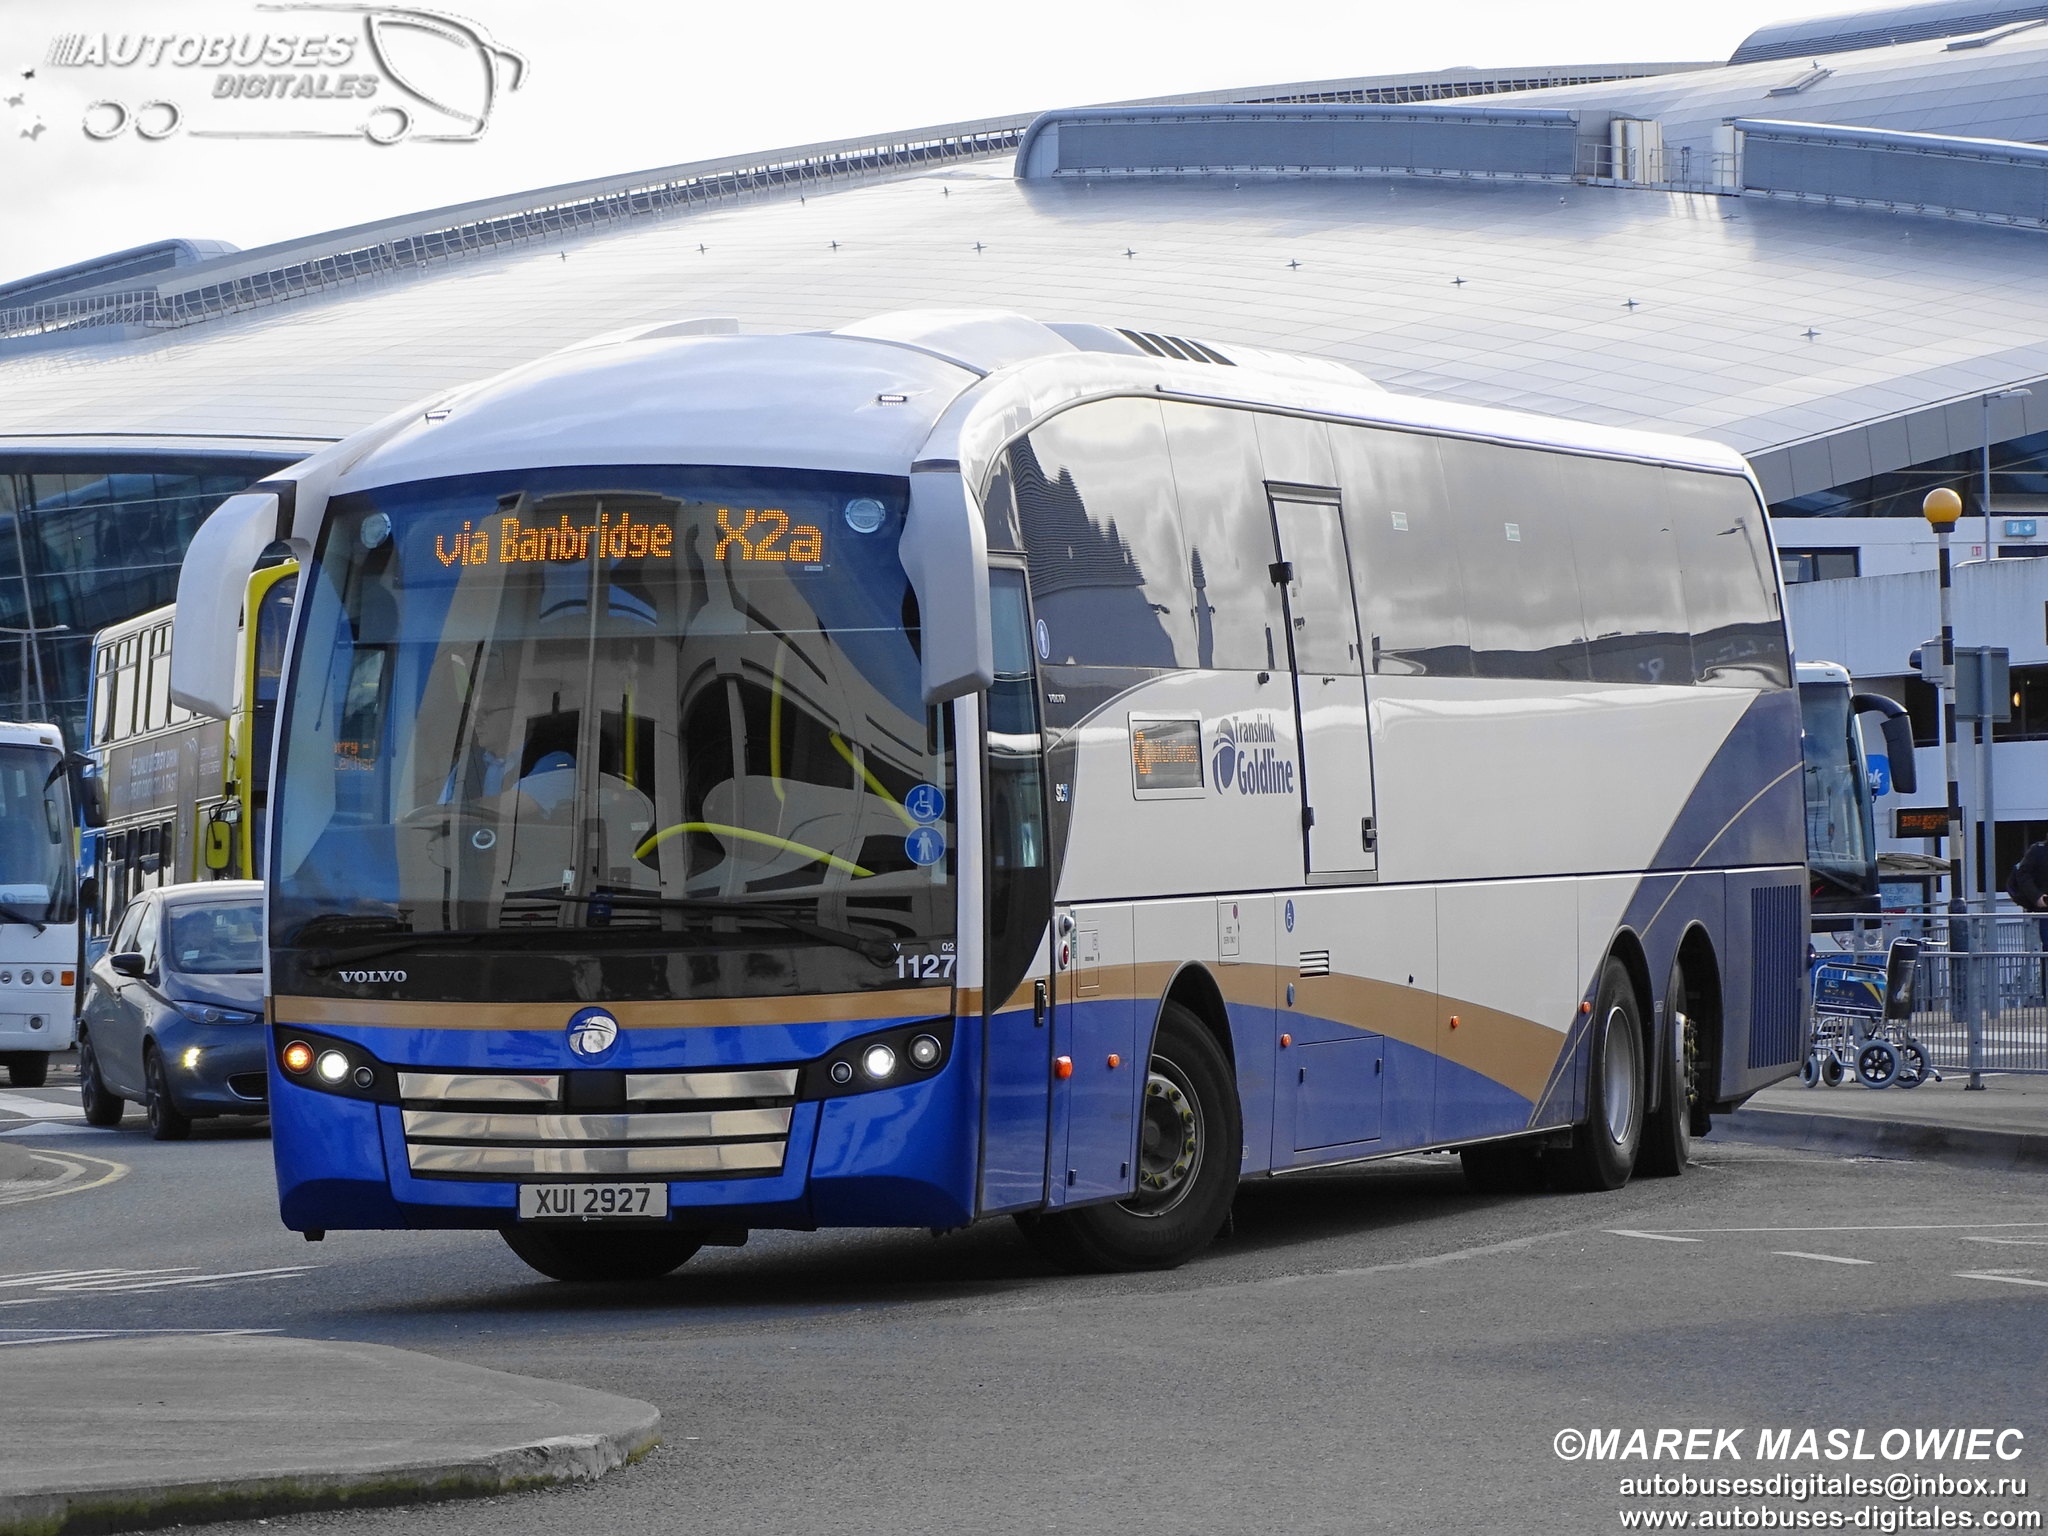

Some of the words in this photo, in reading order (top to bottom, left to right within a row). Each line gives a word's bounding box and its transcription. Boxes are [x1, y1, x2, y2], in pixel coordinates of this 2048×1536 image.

[435, 520, 489, 567] via
[499, 512, 673, 563] Banbridge
[714, 508, 823, 563] X2a
[1233, 713, 1276, 743] Translink
[1237, 747, 1294, 795] Goldline
[941, 943, 955, 952] 02
[338, 970, 408, 983] VOLVO
[895, 954, 956, 979] 1127
[536, 1189, 575, 1213] XUI
[583, 1188, 651, 1213] 2927
